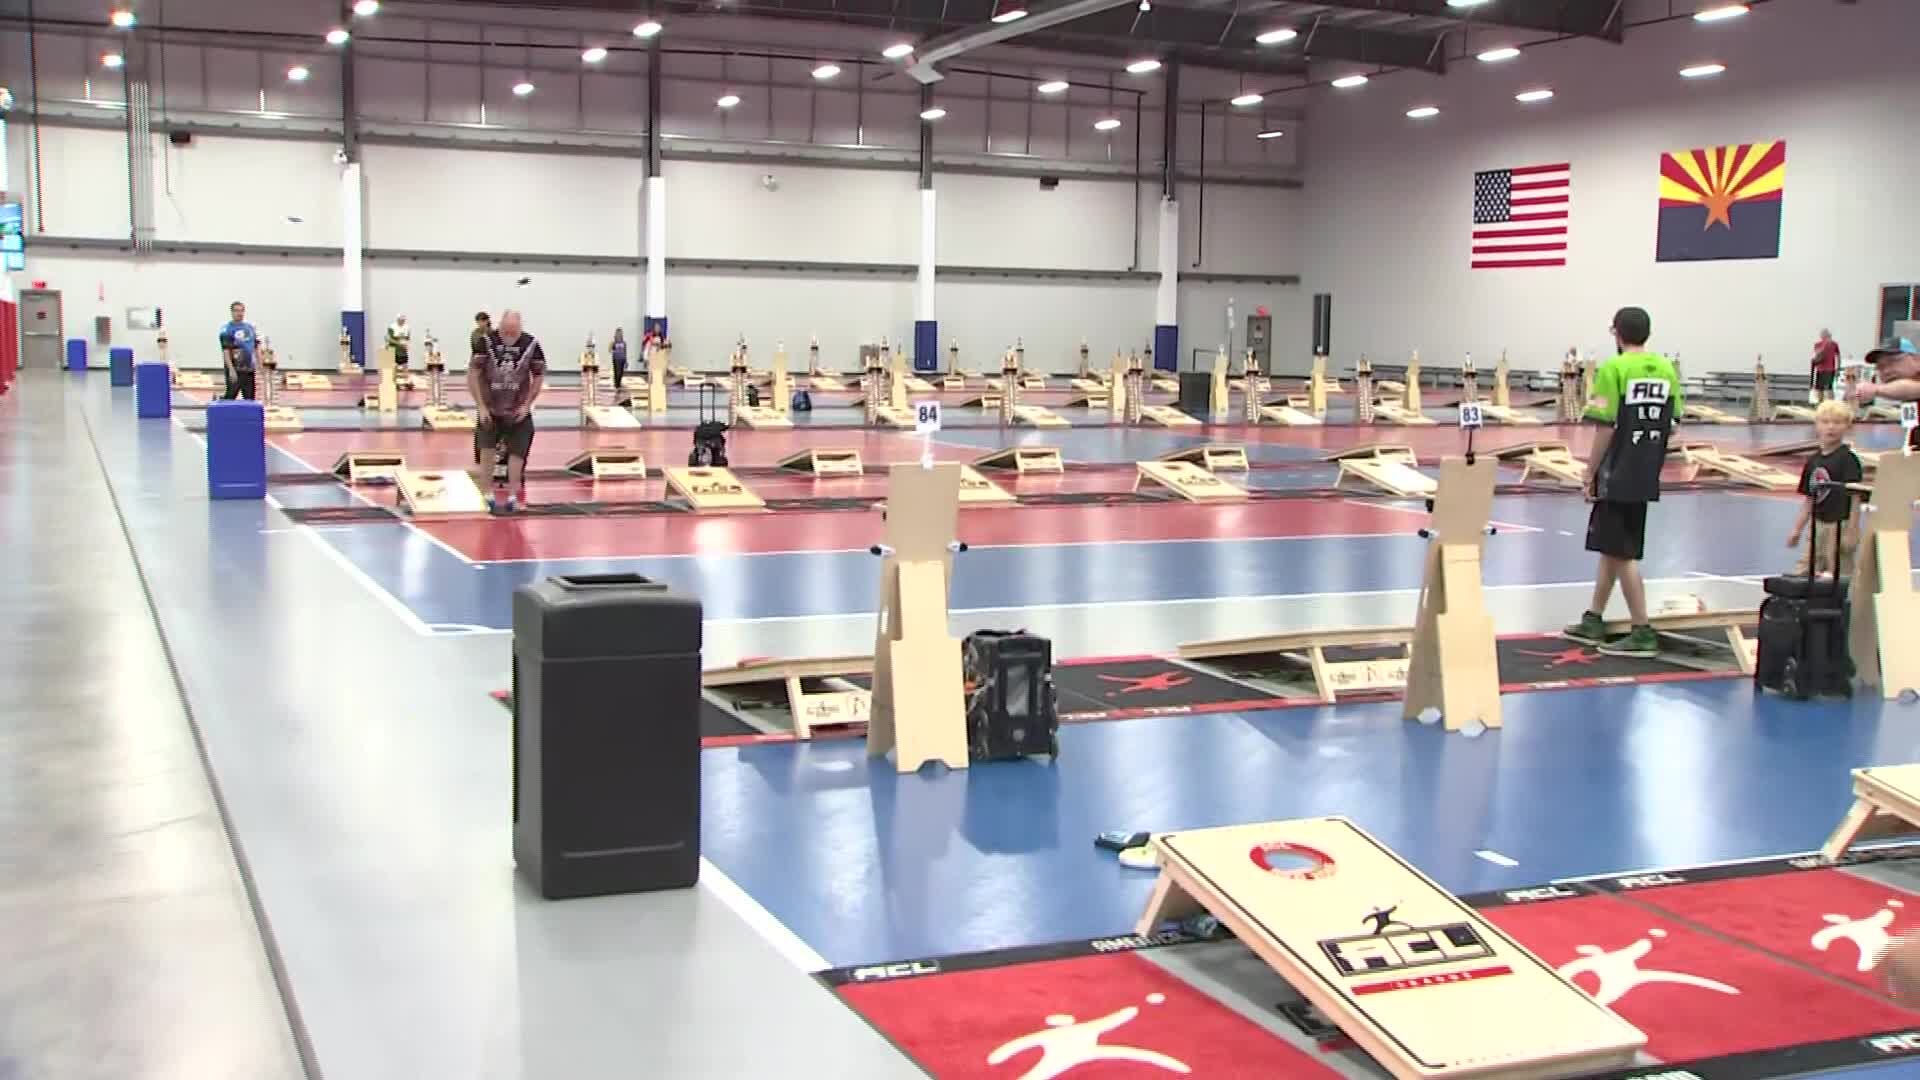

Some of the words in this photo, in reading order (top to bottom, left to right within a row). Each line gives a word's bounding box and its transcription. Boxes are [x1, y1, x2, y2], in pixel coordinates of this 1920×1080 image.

[1632, 382, 1665, 399] ACL
[919, 405, 937, 423] 84
[1463, 406, 1479, 422] 83
[1616, 873, 1687, 888] ACL
[1504, 887, 1577, 902] ACL
[1328, 926, 1491, 973] ACL
[854, 961, 937, 981] ACL
